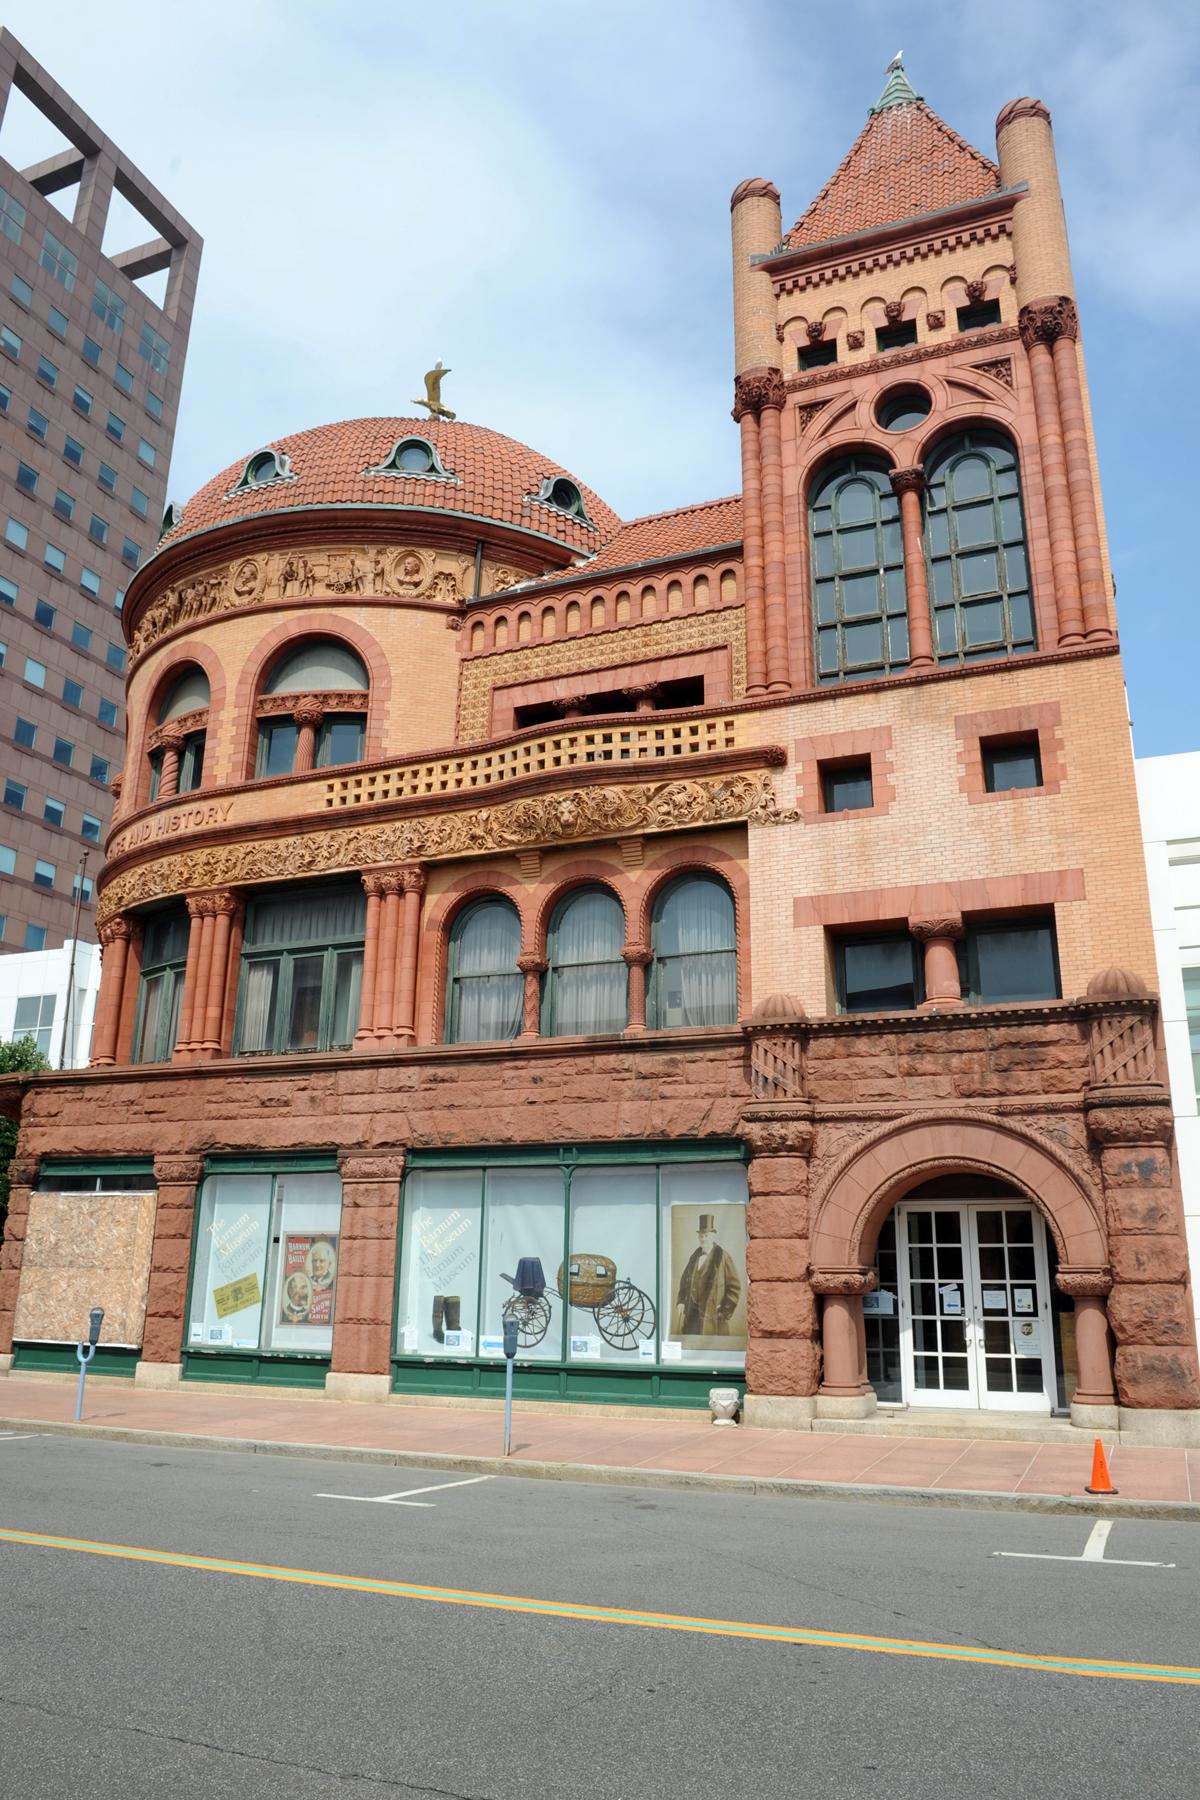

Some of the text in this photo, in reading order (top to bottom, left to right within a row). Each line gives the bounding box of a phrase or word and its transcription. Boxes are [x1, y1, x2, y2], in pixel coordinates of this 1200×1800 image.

[128, 823, 152, 846] AND
[155, 802, 234, 837] HISTORY
[207, 1219, 225, 1233] The
[215, 1213, 250, 1248] Barnum
[220, 1220, 259, 1255] Museum
[414, 1216, 432, 1232] The
[420, 1210, 461, 1248] Barnum
[427, 1218, 472, 1258] Museum
[311, 1300, 330, 1313] SHOW
